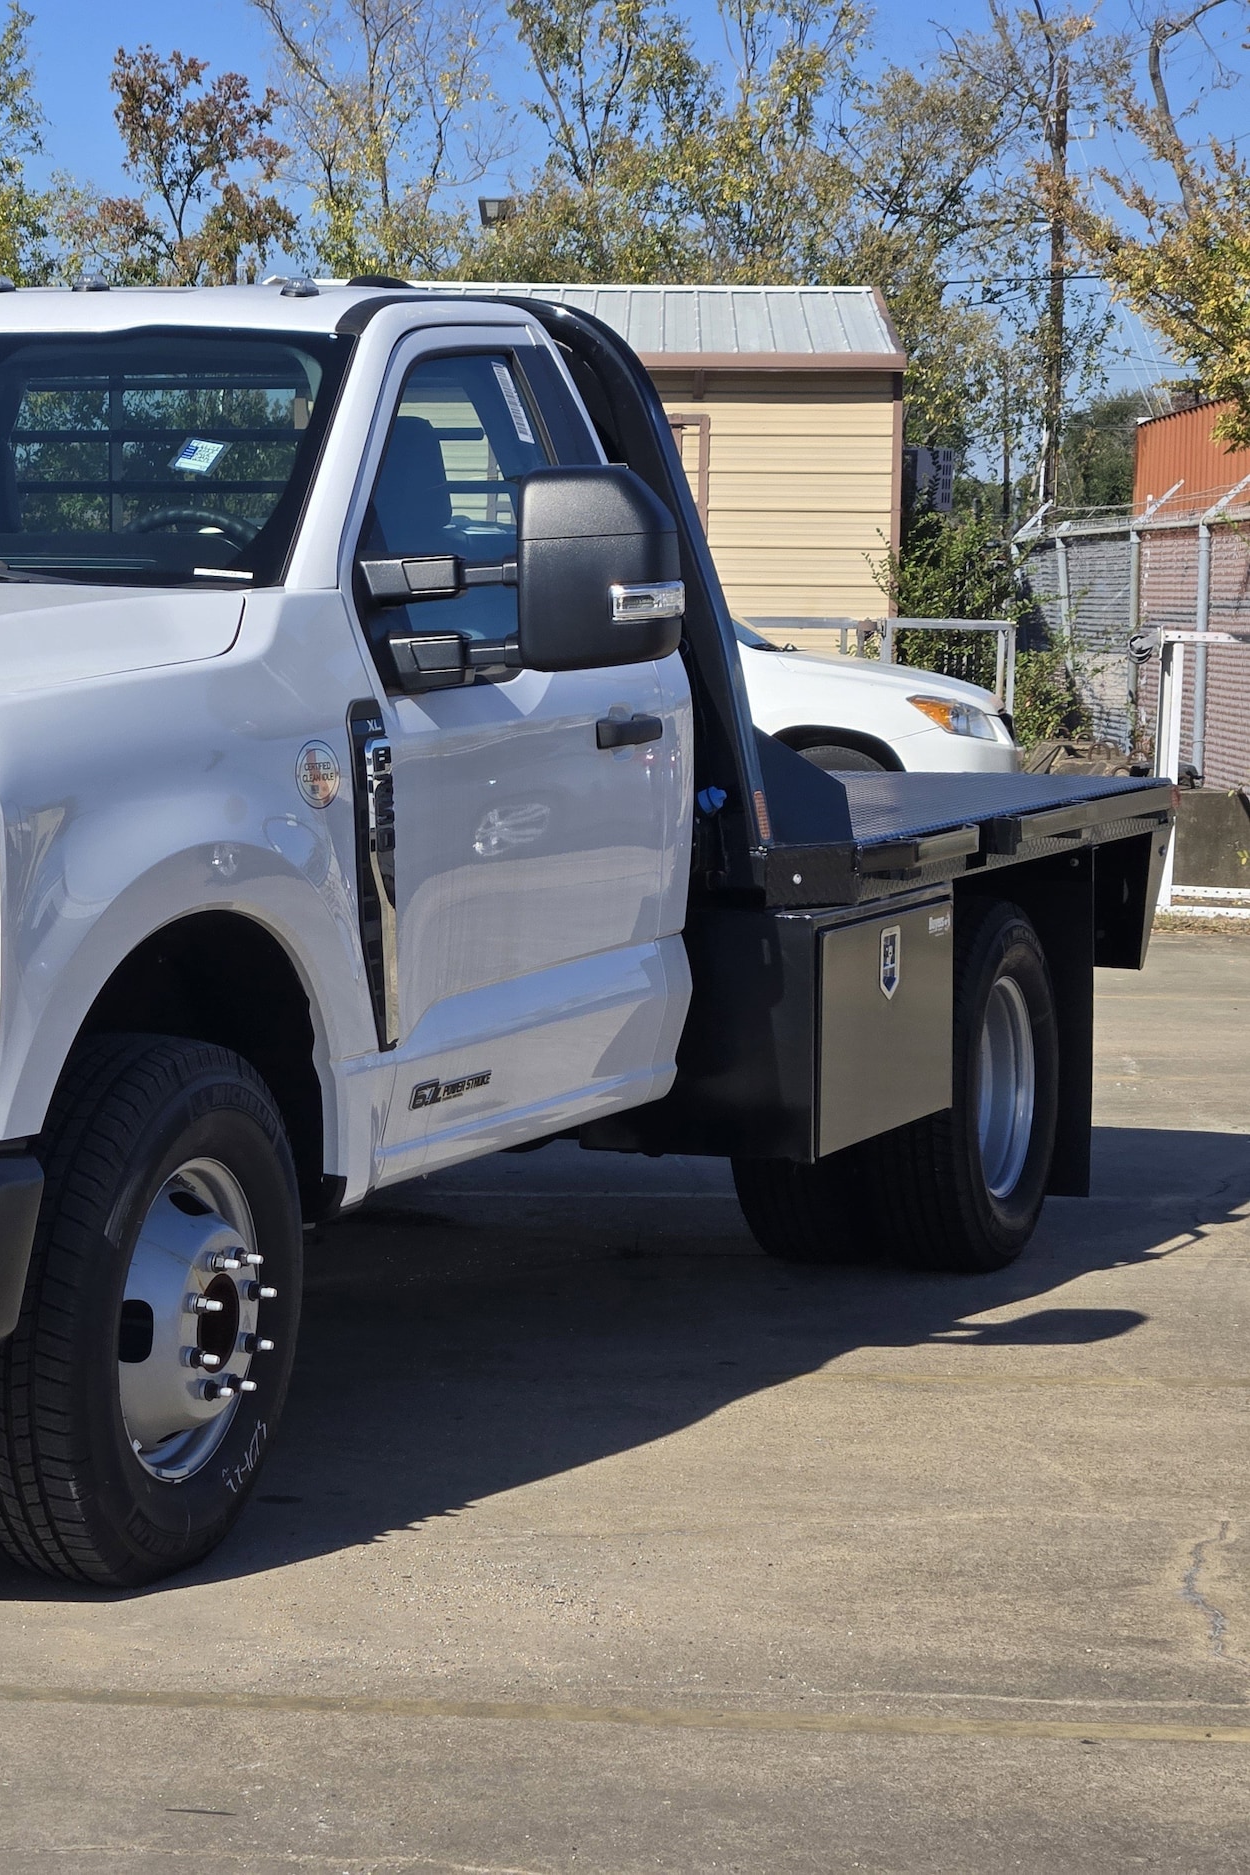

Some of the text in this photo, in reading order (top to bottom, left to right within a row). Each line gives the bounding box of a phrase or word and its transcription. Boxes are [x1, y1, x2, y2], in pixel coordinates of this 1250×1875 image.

[366, 718, 382, 732] XL
[304, 761, 331, 771] CERTIFIED
[302, 773, 321, 783] CLEAN
